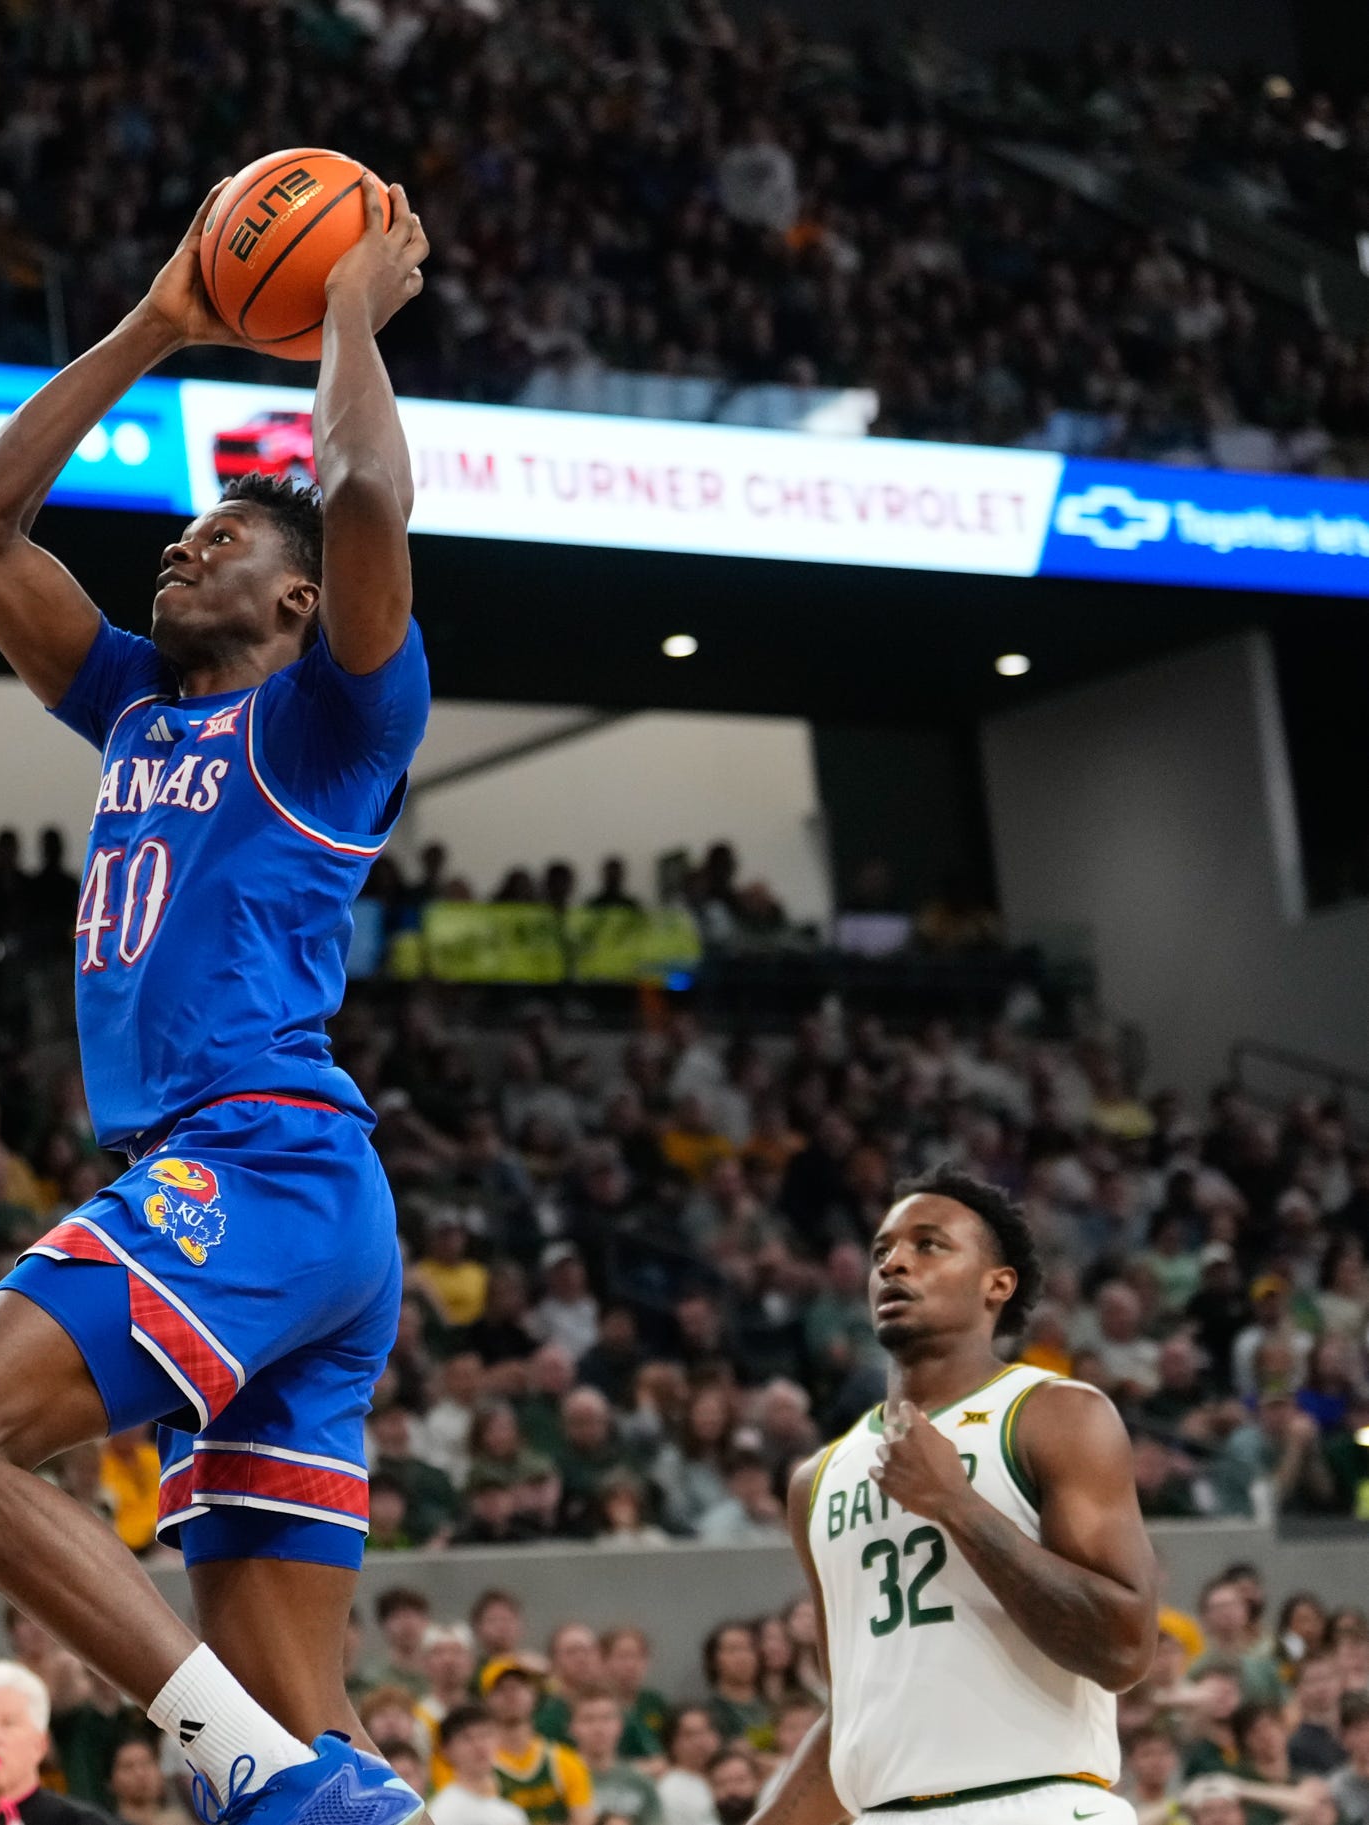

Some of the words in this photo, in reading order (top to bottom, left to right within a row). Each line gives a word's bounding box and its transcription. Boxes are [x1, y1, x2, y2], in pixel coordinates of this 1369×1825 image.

[415, 448, 499, 493] JIM
[517, 453, 726, 513] TURNER
[743, 473, 1027, 534] CHEVROLET
[74, 839, 171, 973] 40
[176, 1201, 204, 1227] KU
[861, 1525, 954, 1638] 32
